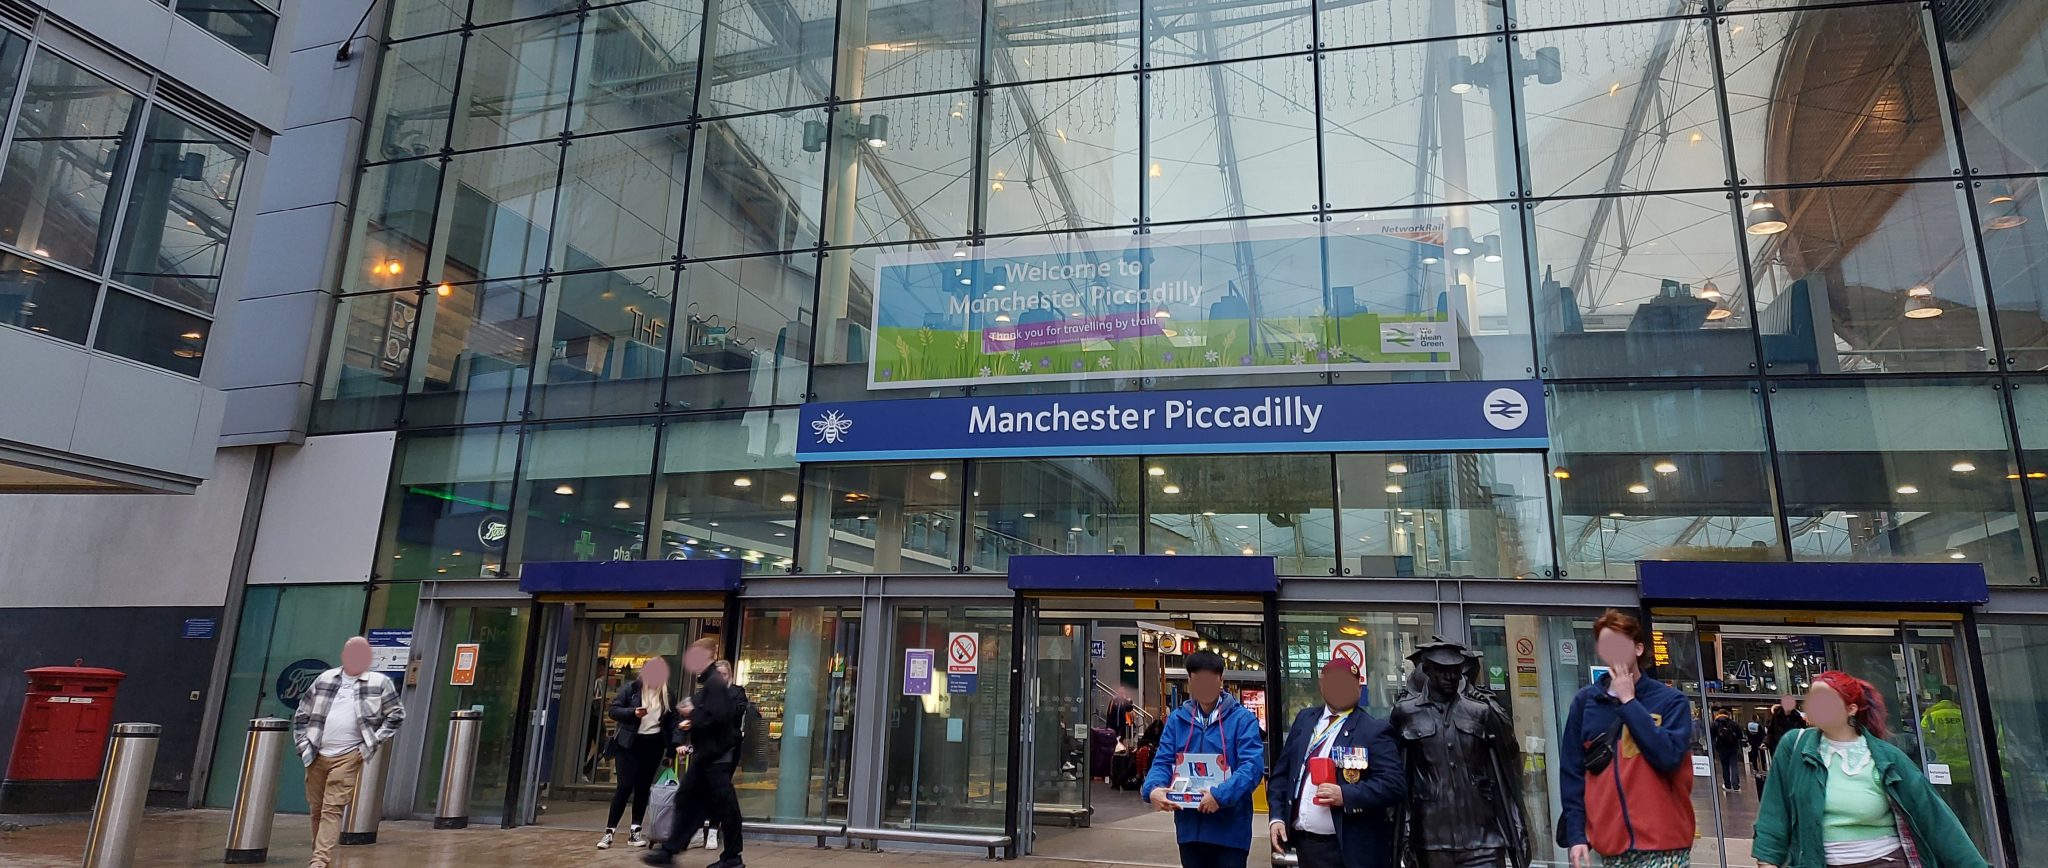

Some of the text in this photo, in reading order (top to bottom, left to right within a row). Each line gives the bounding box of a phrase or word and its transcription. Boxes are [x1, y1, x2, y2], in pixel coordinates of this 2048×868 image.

[1005, 257, 1142, 283] Welcome to
[949, 280, 1203, 315] Manchester Piccadilly
[986, 329, 1022, 341] Thank
[1024, 328, 1044, 341] you
[1046, 325, 1061, 336] for
[1063, 319, 1113, 334] travelling
[1115, 318, 1128, 331] by
[1131, 315, 1157, 327] train
[968, 396, 1323, 434] Manchester Piccadilly
[1735, 660, 1754, 688] 4
